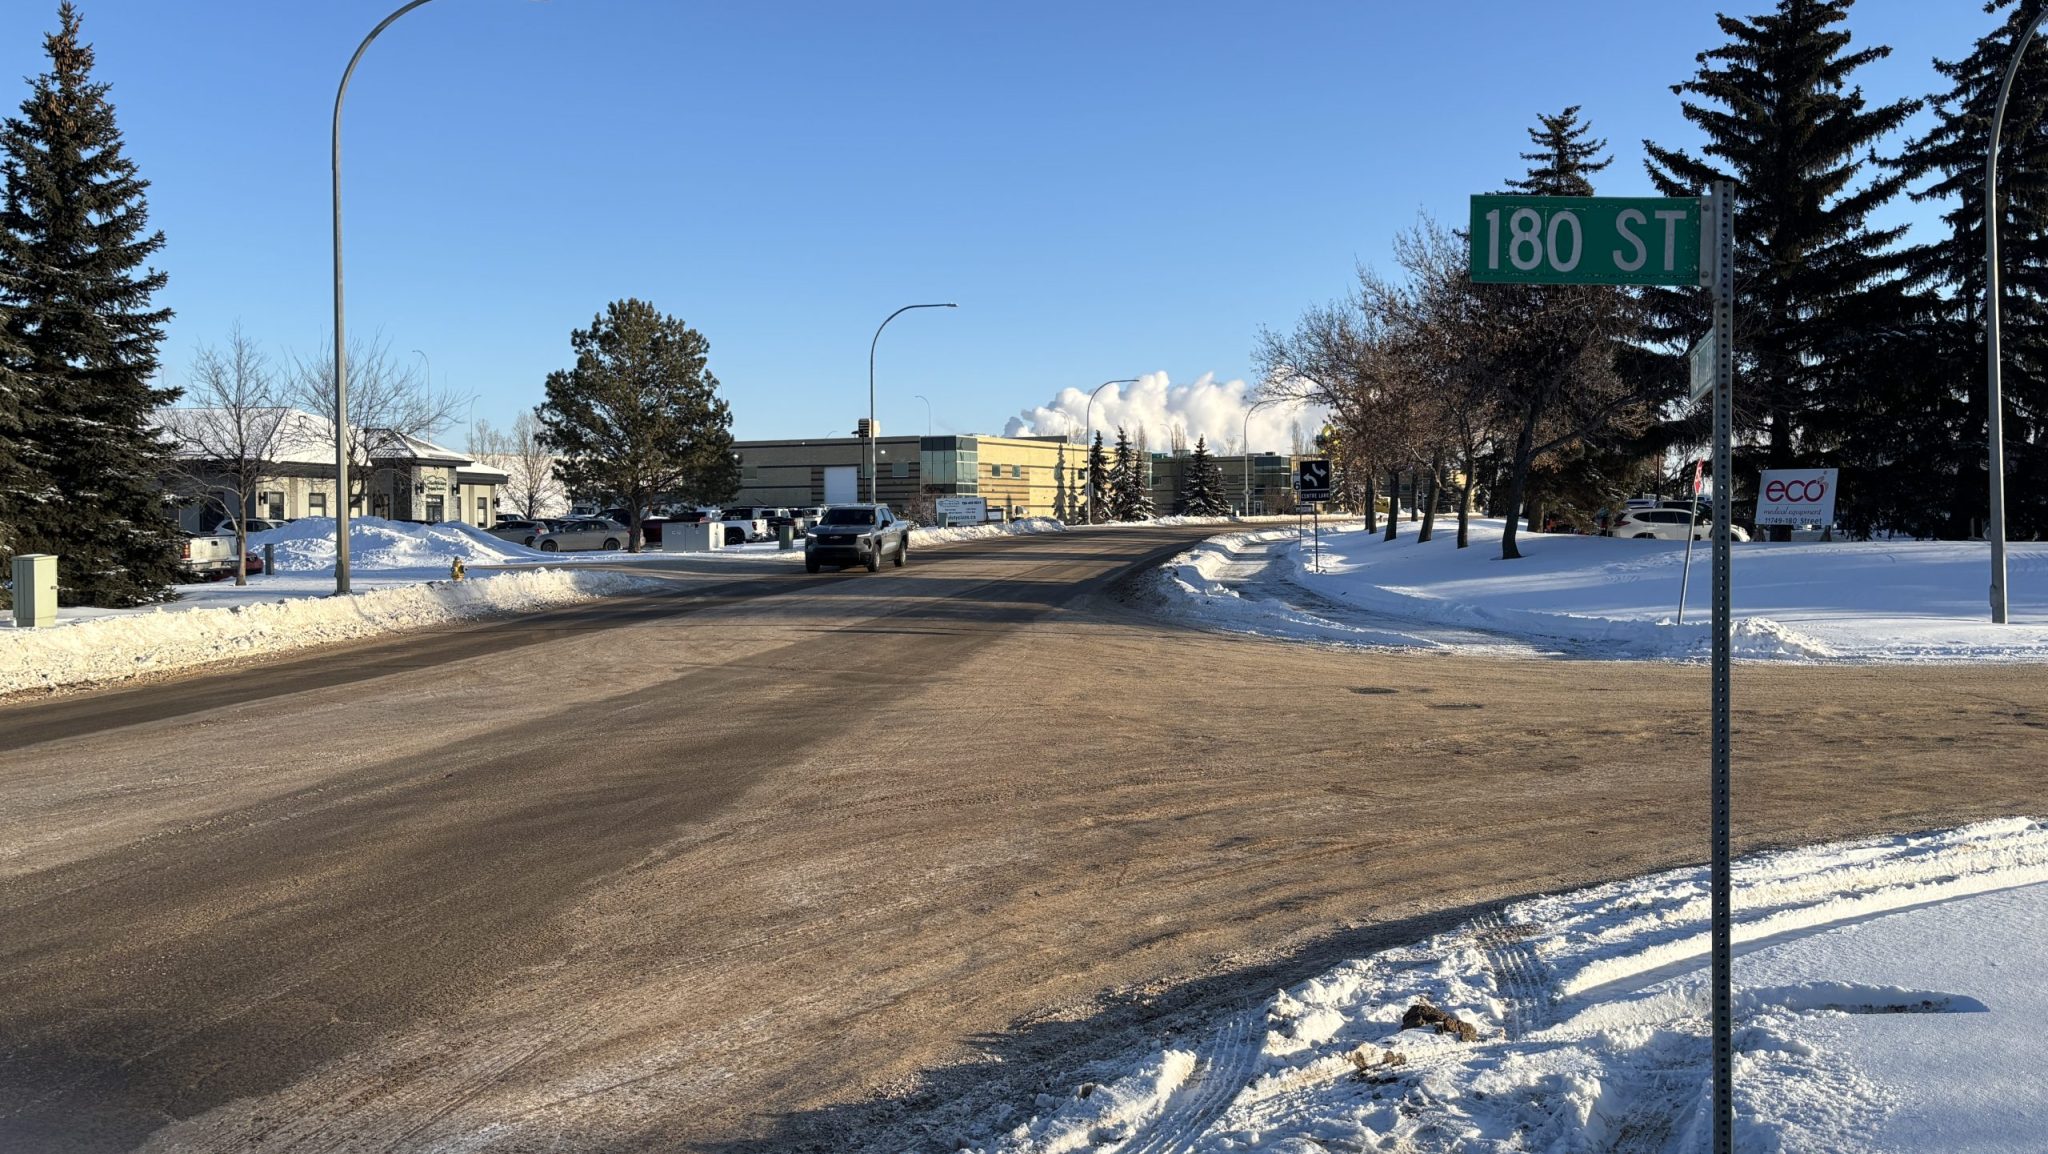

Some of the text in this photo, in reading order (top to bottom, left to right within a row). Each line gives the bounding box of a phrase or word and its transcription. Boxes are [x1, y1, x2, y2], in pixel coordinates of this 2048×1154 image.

[1486, 208, 1687, 272] 180 ST
[1765, 480, 1825, 502] eco
[1763, 506, 1822, 516] medical equipment
